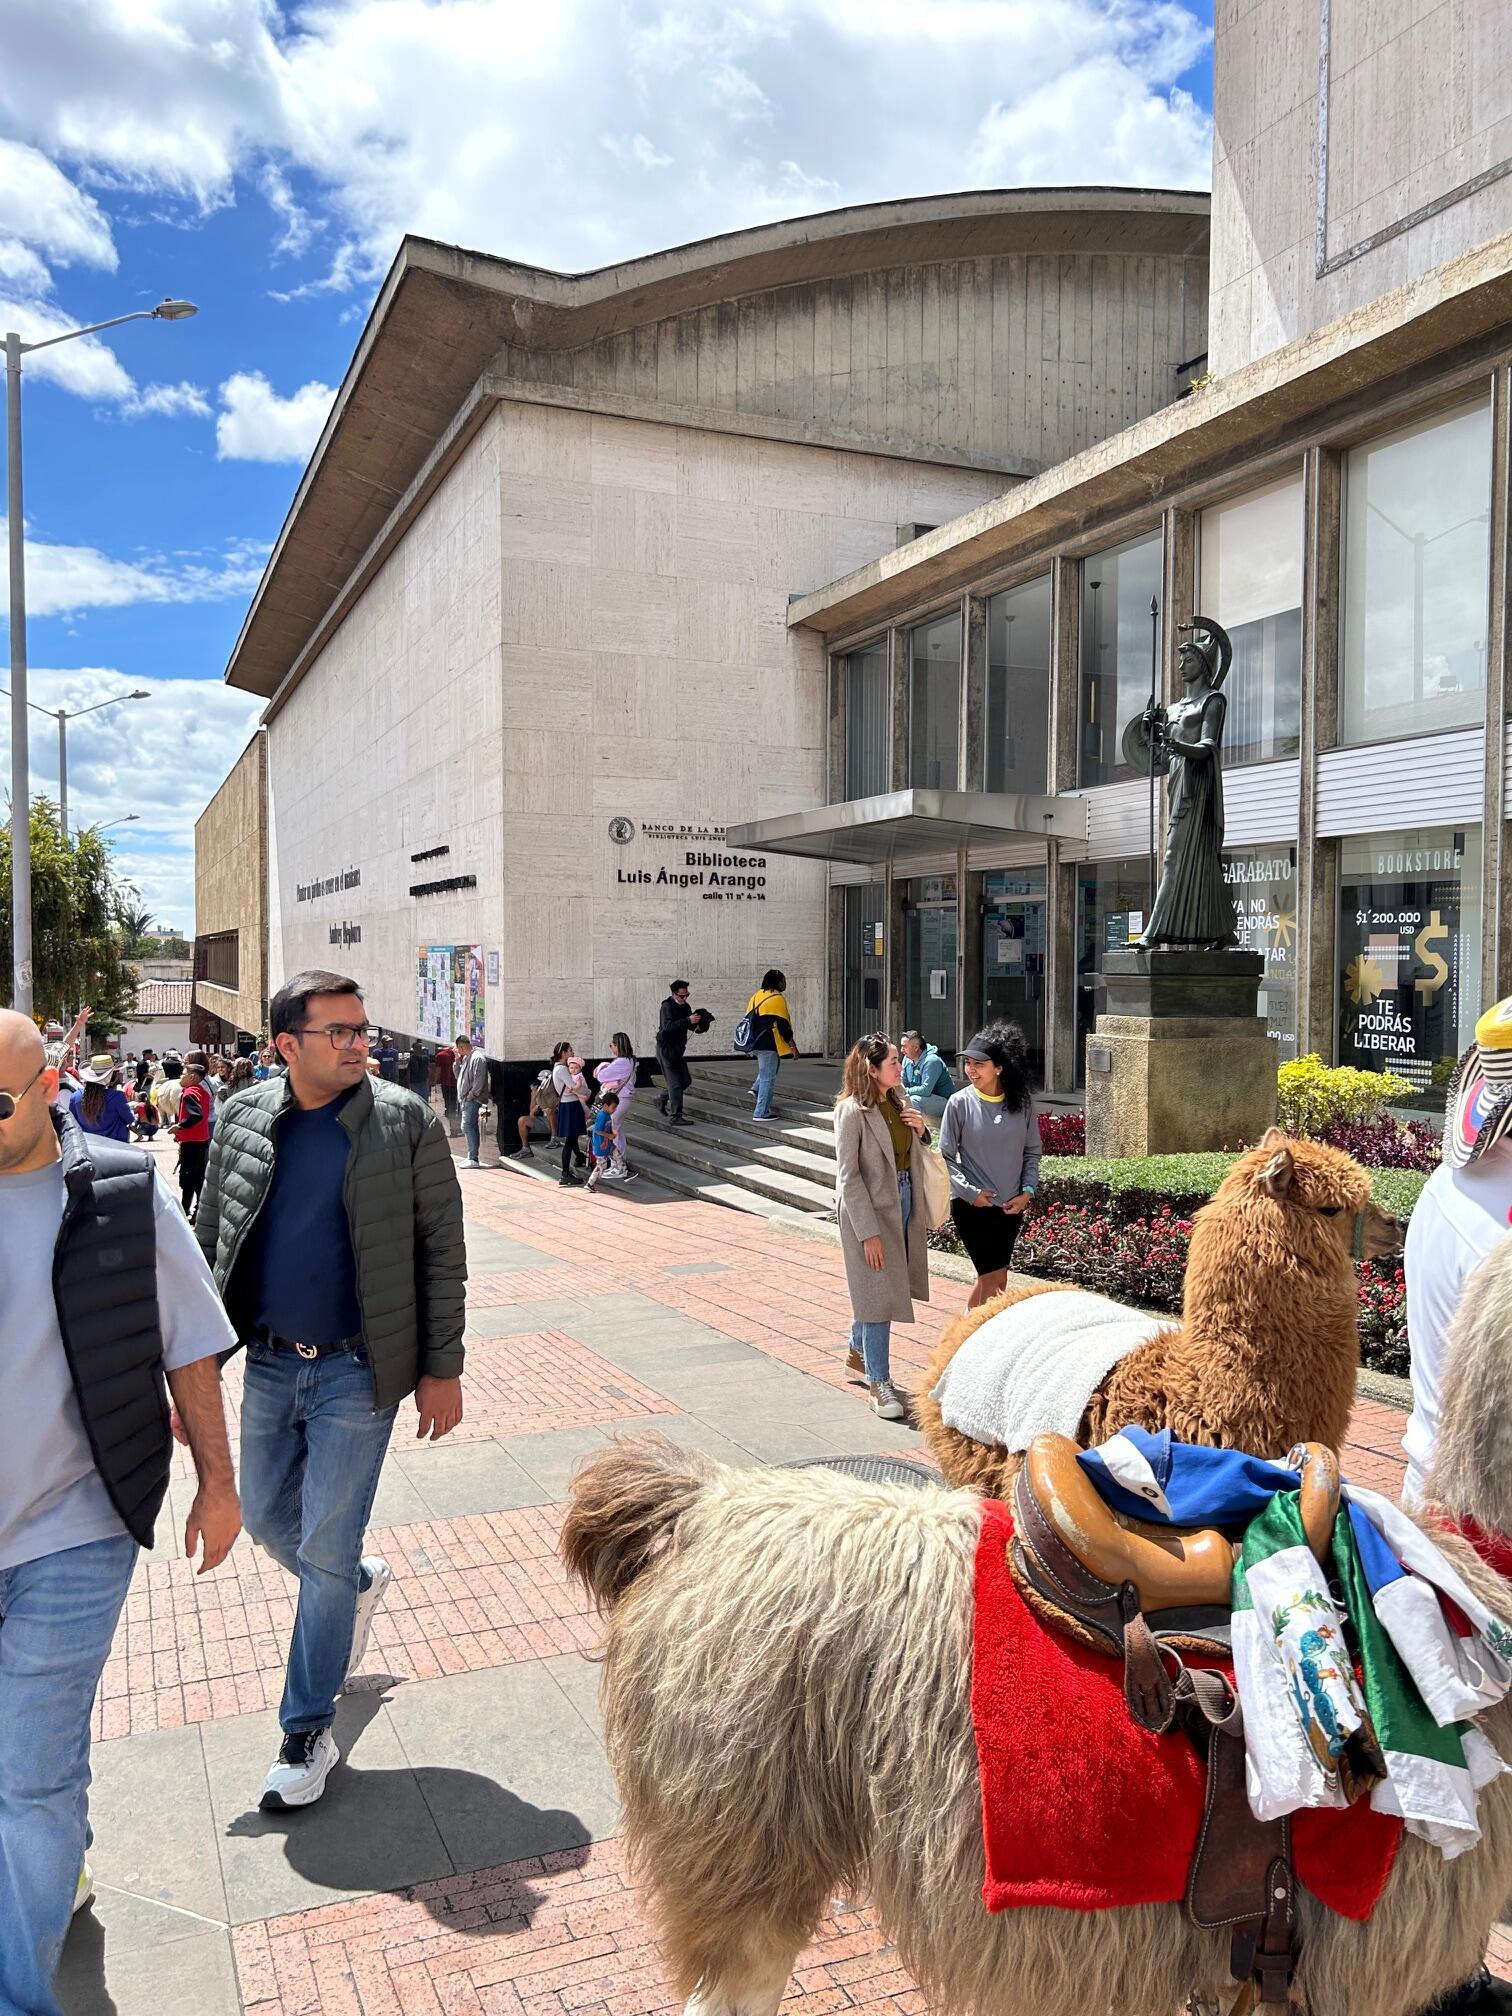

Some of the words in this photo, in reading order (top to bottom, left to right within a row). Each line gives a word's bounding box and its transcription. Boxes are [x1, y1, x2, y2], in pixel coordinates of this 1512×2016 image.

[686, 852, 766, 868] Biblioteca
[1377, 849, 1461, 874] BOOKSTORE
[618, 869, 652, 883] Luis
[655, 867, 703, 888] Ángel
[709, 872, 766, 889] Arango
[703, 892, 723, 900] calle
[747, 893, 766, 901] 4-14
[1250, 899, 1266, 913] NO
[1237, 912, 1280, 930] ENDRÁS
[1233, 930, 1251, 944] UE
[1400, 926, 1415, 934] USD
[1376, 999, 1394, 1015] TE
[1359, 1013, 1412, 1033] PODRÁS
[1354, 1033, 1416, 1053] LIBERAR
